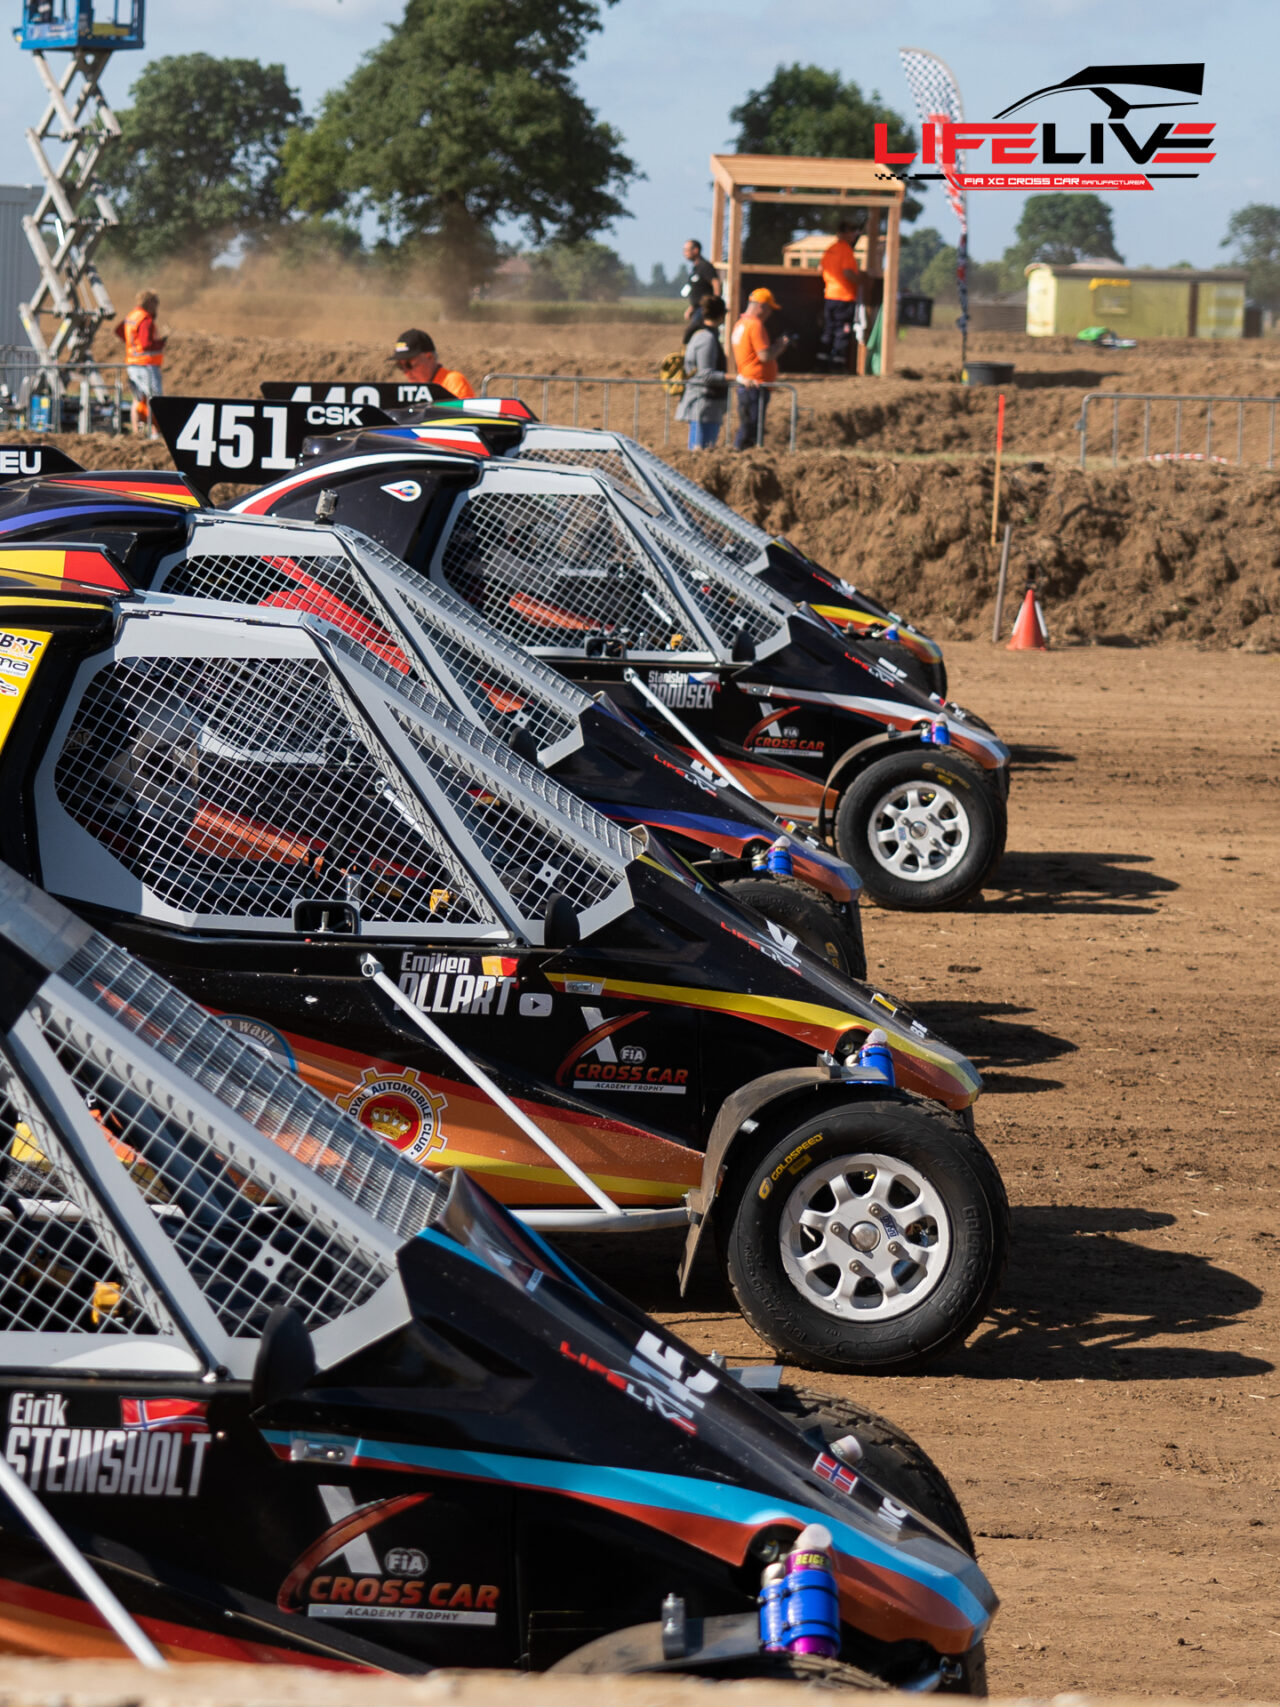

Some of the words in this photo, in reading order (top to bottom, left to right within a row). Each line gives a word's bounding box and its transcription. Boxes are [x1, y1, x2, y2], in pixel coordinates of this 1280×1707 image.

[398, 385, 433, 403] ITA
[306, 406, 363, 426] CSK
[176, 402, 296, 470] 451
[755, 737, 797, 749] CROSS
[799, 740, 825, 751] CAR
[400, 952, 470, 975] Emilien
[239, 1020, 276, 1046] wash
[620, 1049, 645, 1062] FIA
[574, 1063, 642, 1083] CROSS
[646, 1066, 689, 1084] CAR
[594, 1082, 631, 1090] ACADEMY
[633, 1084, 664, 1092] TROPHY
[349, 1092, 369, 1116] OYAL
[371, 1081, 432, 1120] AUTOMOBILE
[413, 1123, 432, 1153] CLUB
[771, 1134, 823, 1181] GOLDSPEED
[9, 1392, 69, 1427] Eirik
[5, 1426, 212, 1497] STEINSHOLT
[387, 1552, 425, 1571] FIA
[308, 1575, 425, 1605] CROSS
[428, 1582, 500, 1609] CAR
[345, 1607, 405, 1619] ACADEMY
[409, 1609, 459, 1622] TROPHY
